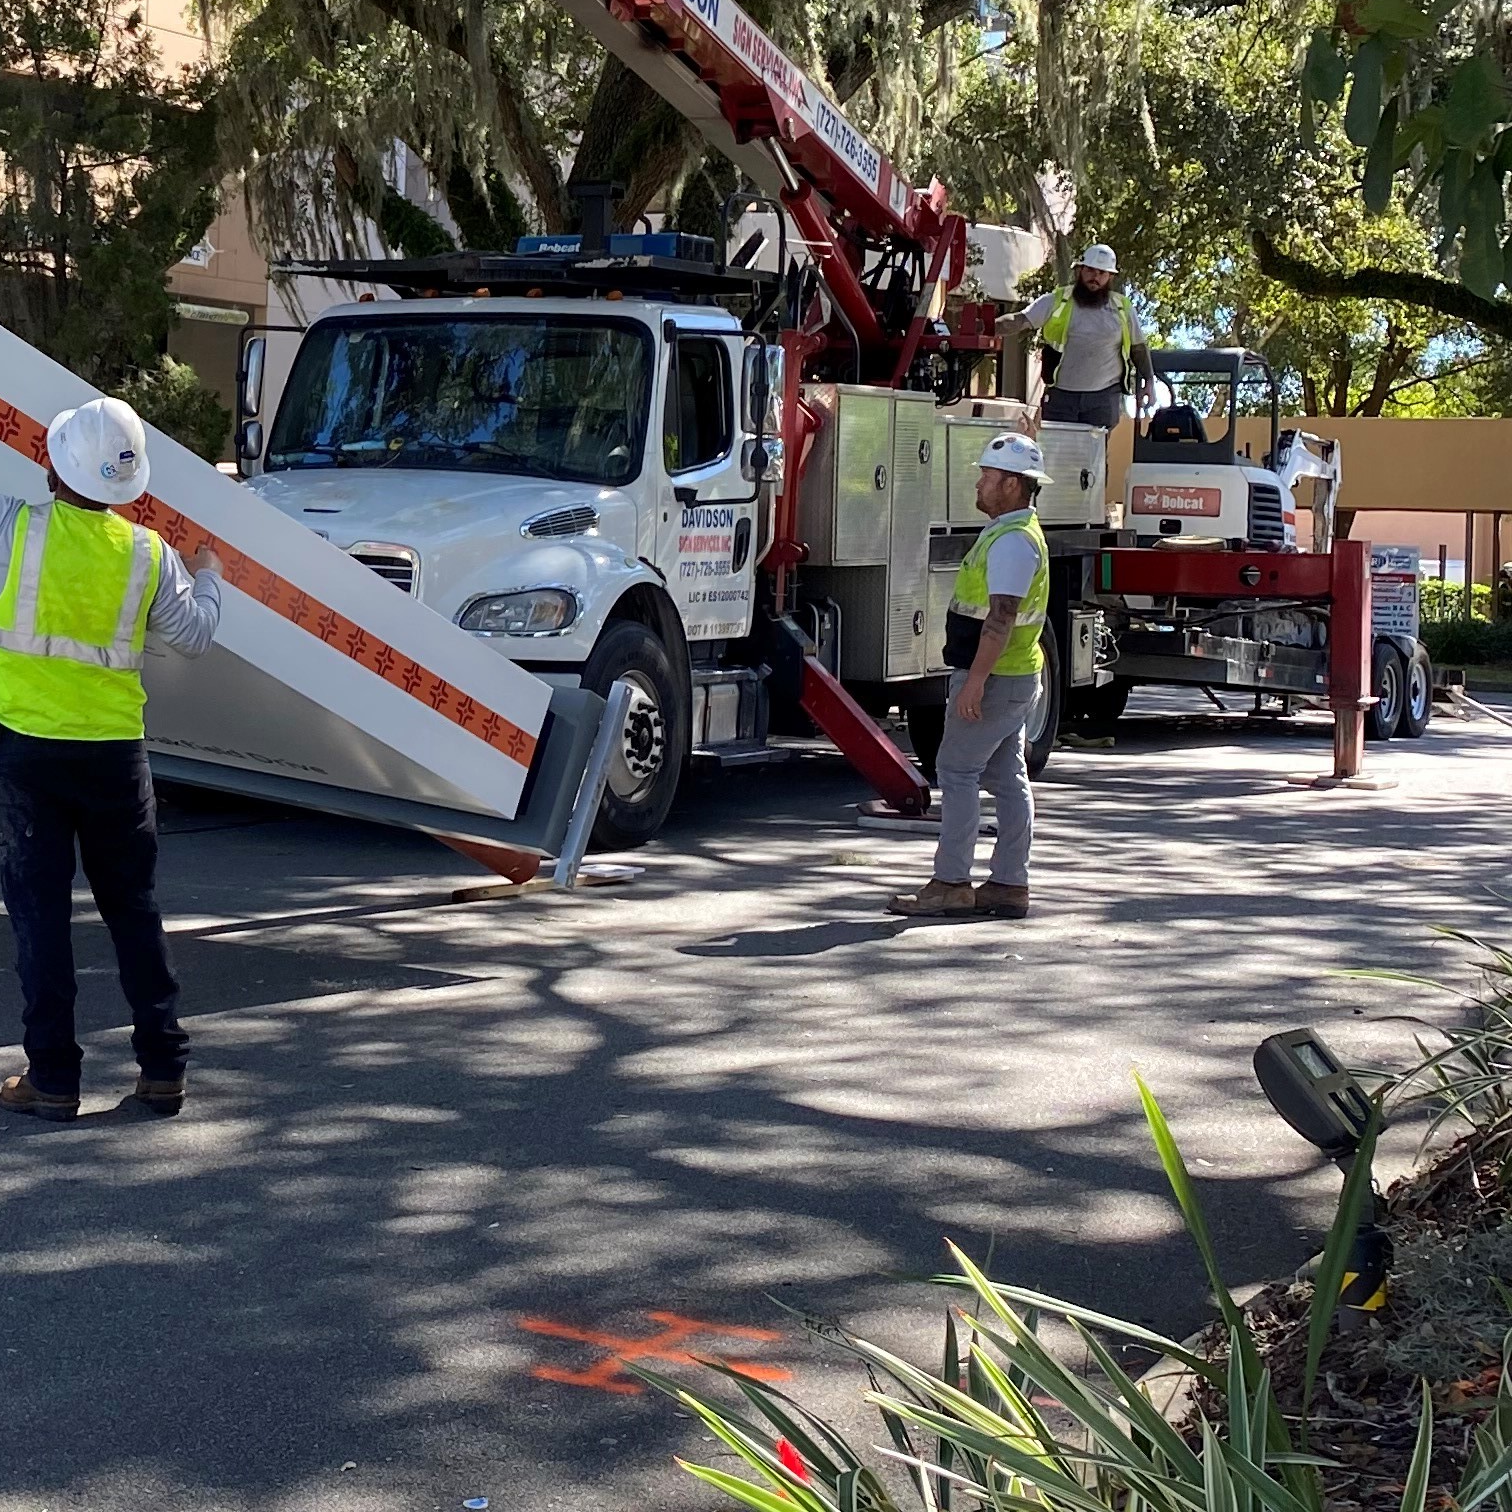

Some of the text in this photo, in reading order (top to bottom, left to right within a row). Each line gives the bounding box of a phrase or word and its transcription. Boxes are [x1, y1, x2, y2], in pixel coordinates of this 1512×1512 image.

[732, 11, 752, 59] SIGN
[816, 99, 877, 184] (727)-726-3555
[538, 242, 581, 253] Bobcat
[1162, 494, 1204, 510] Bobcat
[681, 509, 734, 529] DAVIDSON
[689, 591, 701, 603] LIC
